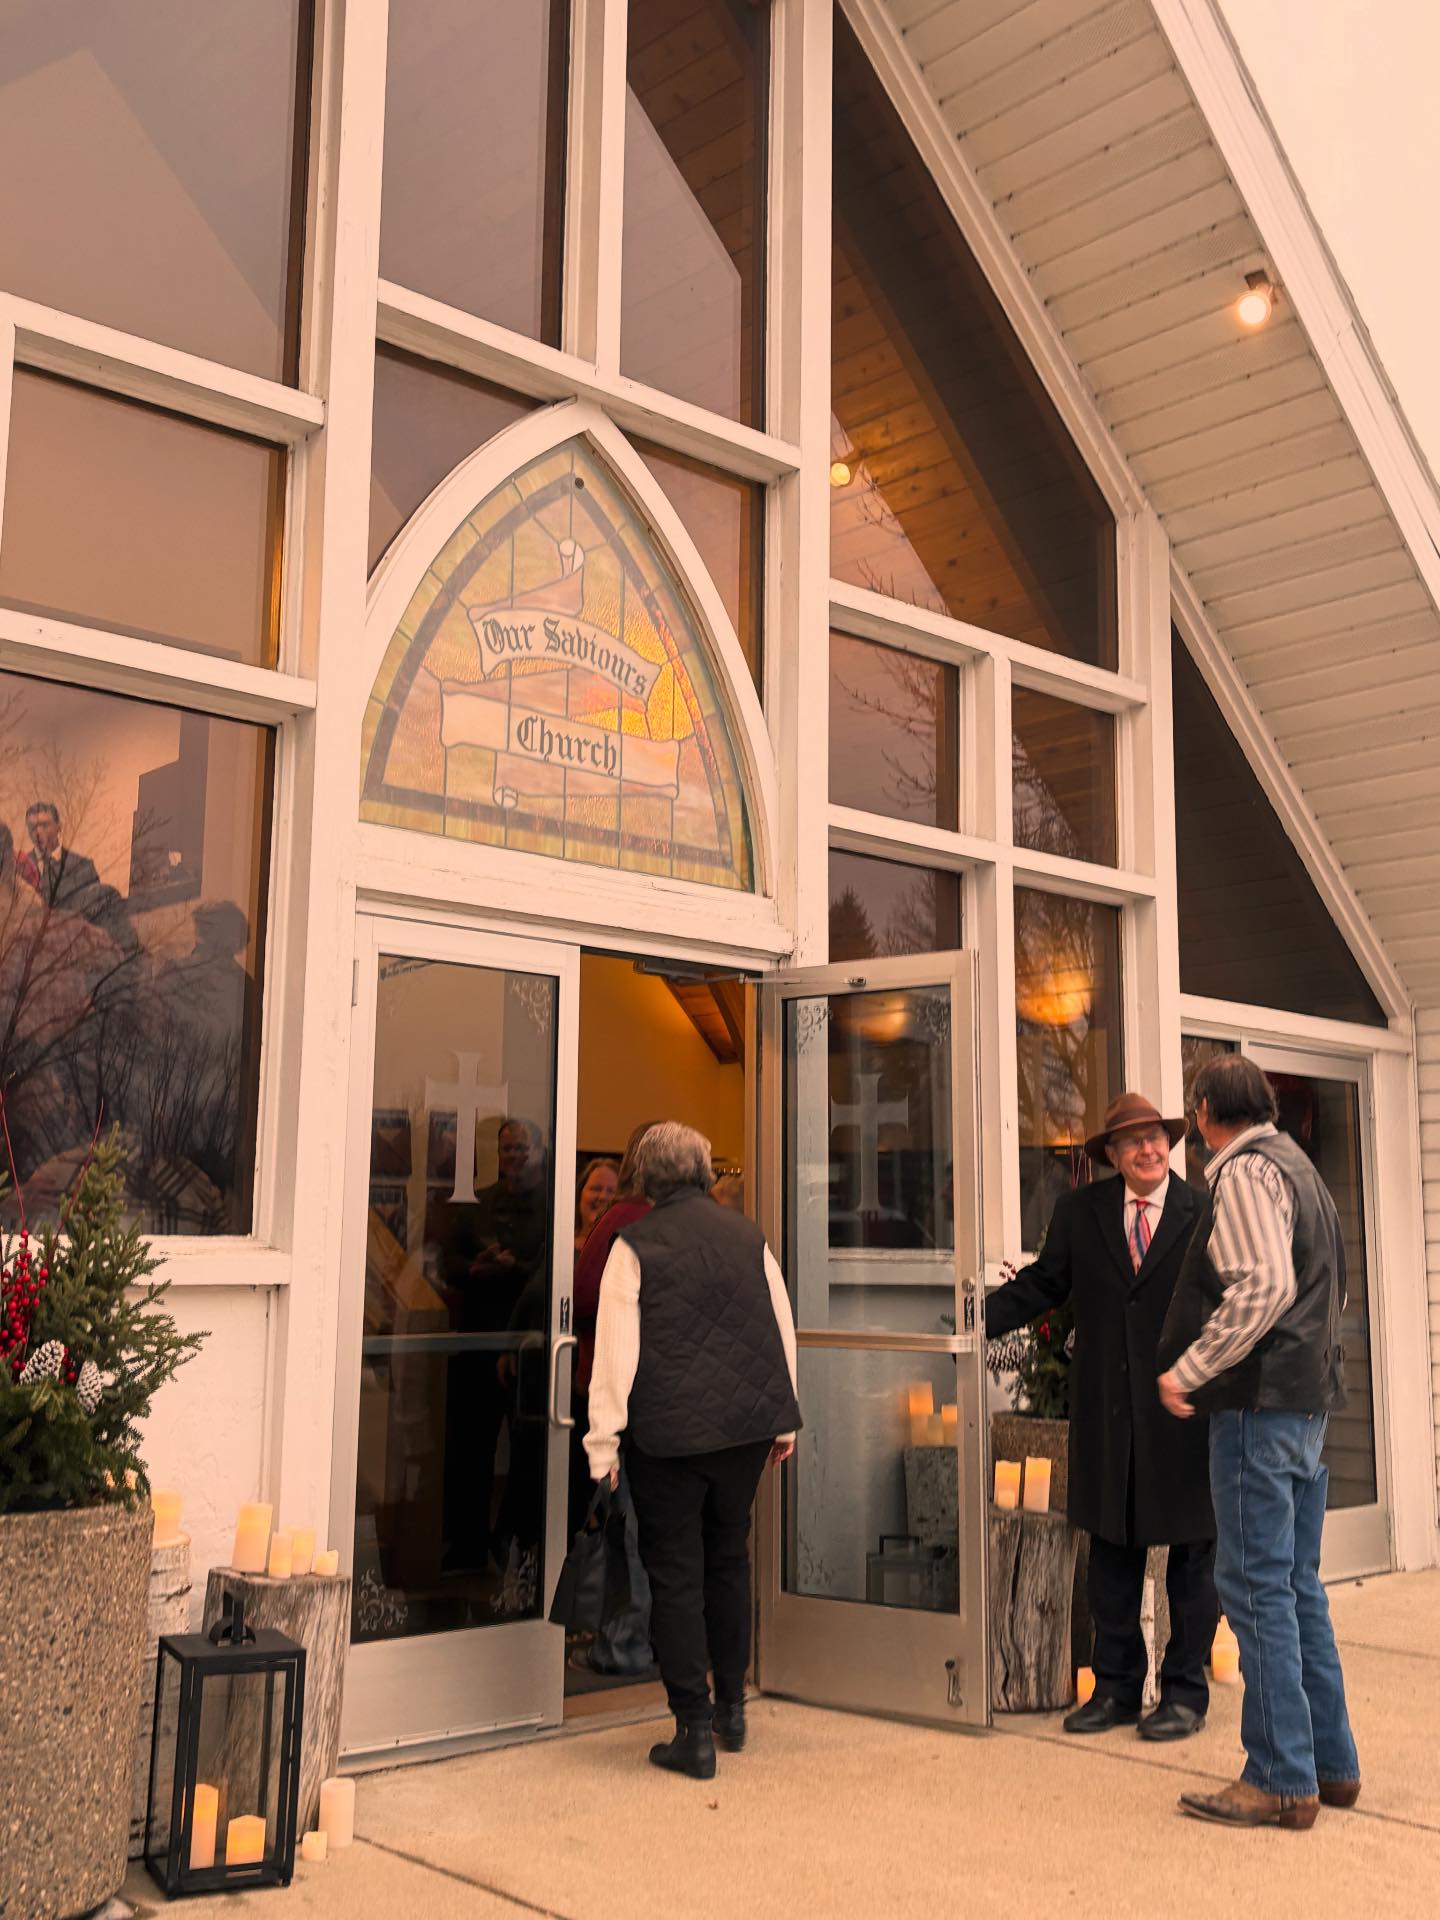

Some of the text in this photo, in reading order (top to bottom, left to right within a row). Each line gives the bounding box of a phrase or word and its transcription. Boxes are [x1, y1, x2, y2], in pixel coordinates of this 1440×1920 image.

[482, 617, 648, 695] Our Saviours
[517, 716, 617, 776] Church
